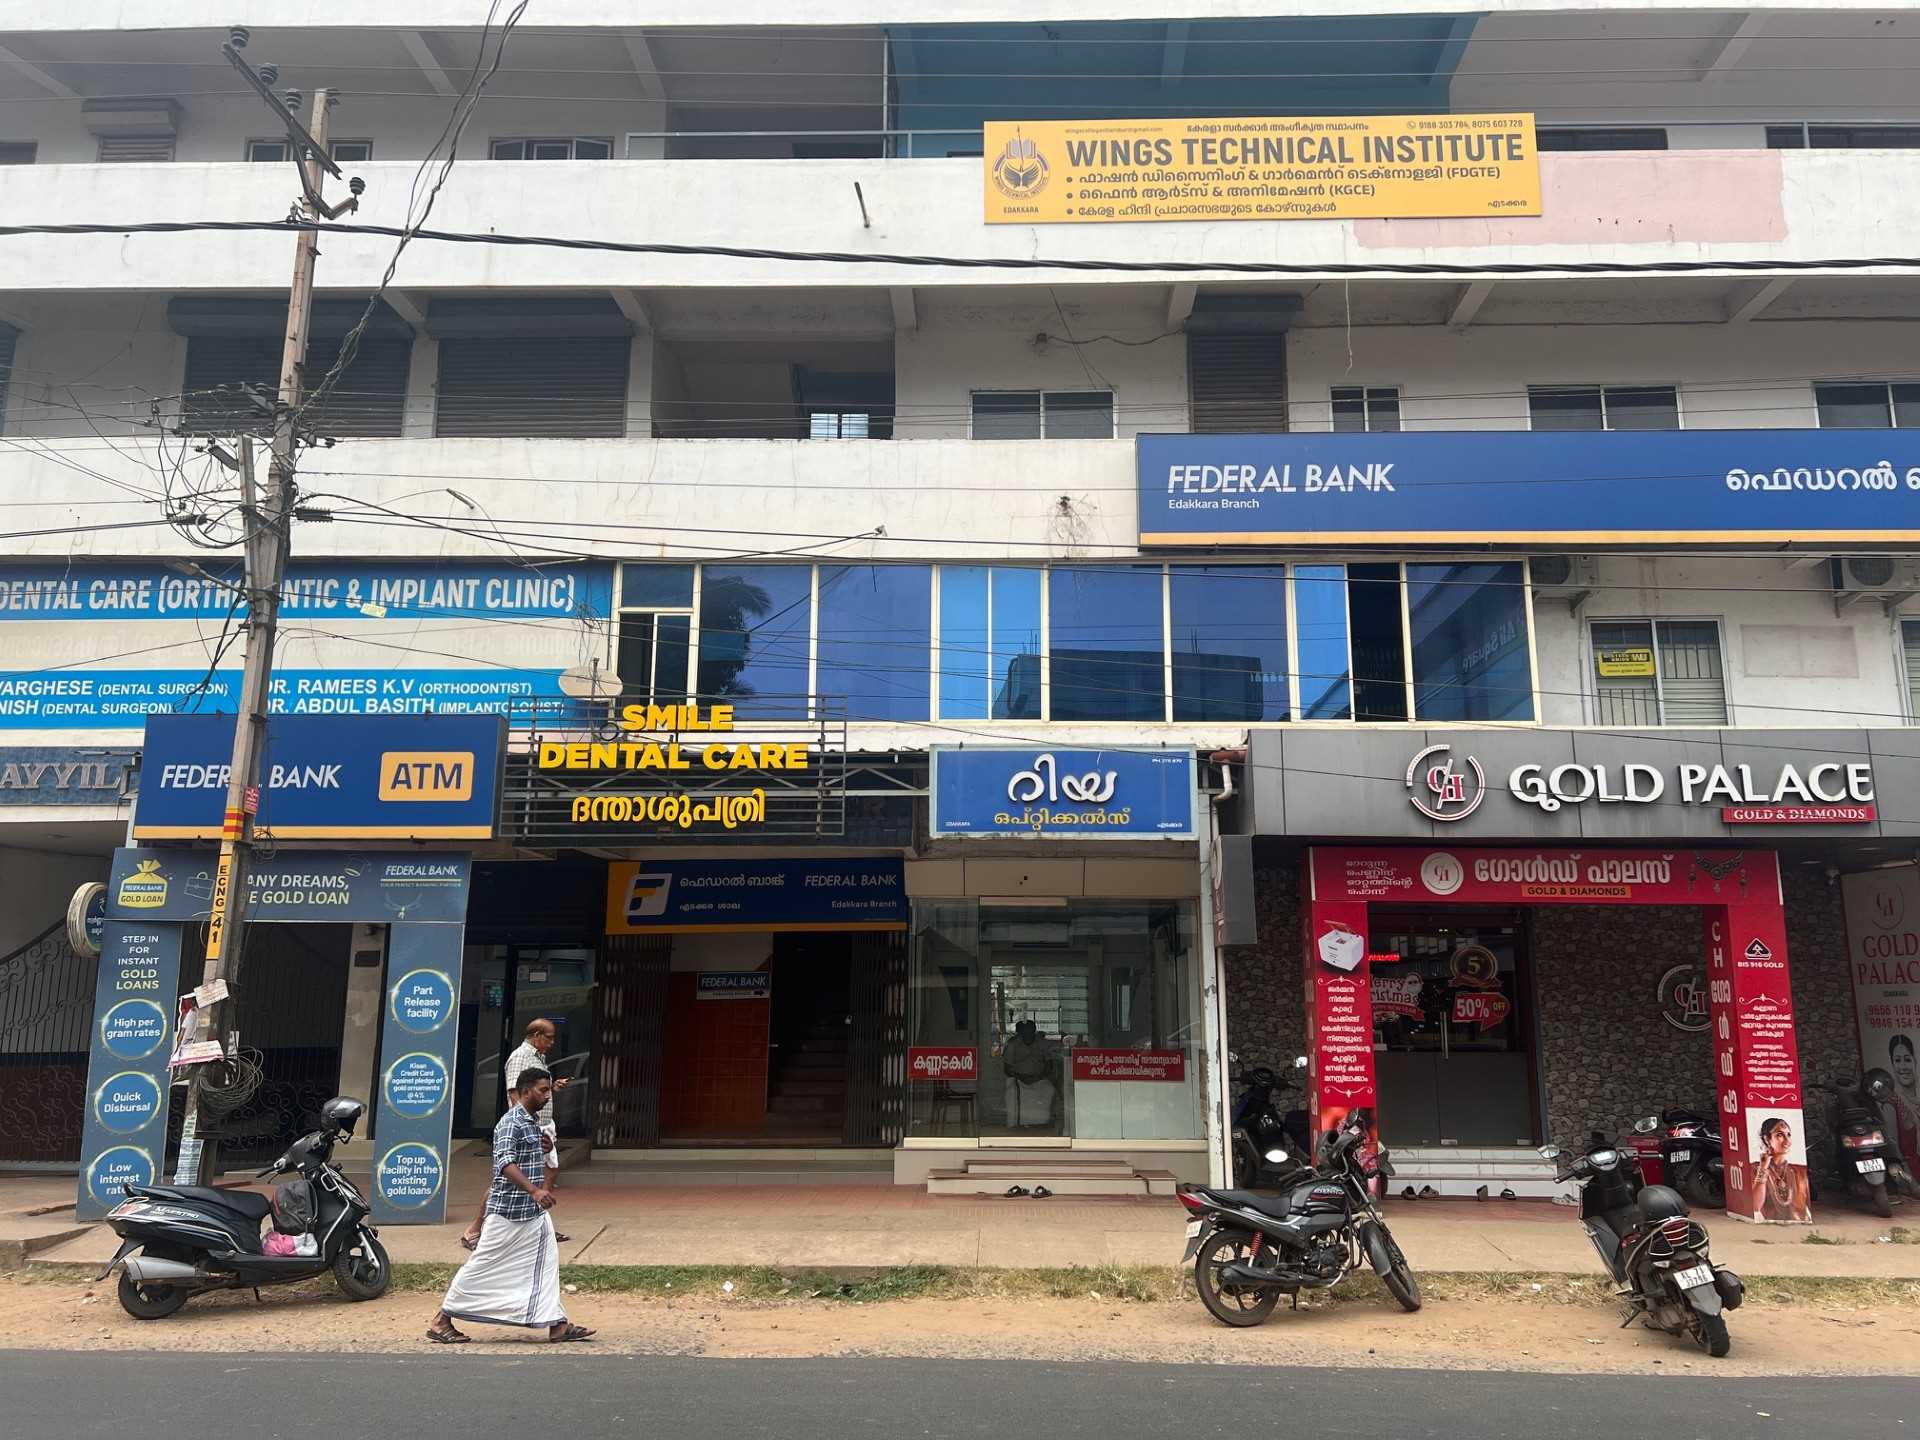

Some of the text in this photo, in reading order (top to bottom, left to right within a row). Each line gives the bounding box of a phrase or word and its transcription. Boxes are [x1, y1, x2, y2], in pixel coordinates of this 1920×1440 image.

[1066, 133, 1525, 167] WINGS TECHNICAL INSTITUTE
[1079, 169, 1139, 183] ഫാഷൻ
[1249, 170, 1259, 181] &
[1447, 166, 1501, 180] (FDGTE)
[1080, 186, 1138, 200] ഫൈൻ
[1213, 186, 1222, 198] &
[1227, 183, 1325, 199] അനിമേഷൻ
[1330, 183, 1376, 198] (KGCE)
[1078, 205, 1115, 217] കേരള
[1168, 463, 1396, 493] FEDERAL BANK
[1726, 460, 1897, 490] ഫെഡറൽ
[1169, 498, 1260, 510] Edakkara Branch
[0, 580, 82, 610] DENTAL
[89, 579, 152, 610] CARE
[345, 578, 362, 608] &
[370, 578, 480, 609] IMPLANT
[486, 575, 575, 613] CLINIC)
[98, 683, 153, 698] (DENTAL
[157, 682, 229, 698] SURGEON)
[298, 679, 377, 695] RAMEES
[383, 679, 414, 695] K.V
[419, 682, 533, 697] (ORTHODONTIST)
[42, 702, 97, 716] (DENTAL
[101, 702, 174, 716] SURGEON)
[267, 698, 290, 713] R.
[294, 698, 359, 714] ABDUL
[368, 698, 435, 714] BASITH
[622, 704, 735, 732] SMILE
[538, 742, 808, 770] DENTAL CARE
[268, 764, 343, 788] BANK
[390, 762, 463, 790] ATM
[1508, 762, 1875, 812] GOLD PALACE
[571, 787, 766, 829] ദന്താശുപത്രി
[1733, 808, 1865, 821] GOLD & DIAMONDS
[385, 865, 459, 876] FEDERAL BANK
[1588, 853, 1674, 884] പാലസ്
[281, 874, 350, 891] DREAMS,
[680, 873, 746, 887] ഫെഡറൽ
[805, 874, 898, 887] FEDERAL BANK
[1527, 886, 1558, 895] GOLD
[1569, 886, 1626, 896] DIAMONDS
[120, 895, 164, 903] GOLD LOAN
[262, 890, 309, 904] GOLD
[309, 890, 350, 905] LOAN
[832, 900, 897, 909] Edakkara Branch
[122, 935, 160, 944] STEP IN
[1863, 933, 1919, 958] GOLD
[129, 946, 151, 954] FOR
[118, 957, 160, 966] INSTANT
[1763, 961, 1785, 969] GOLD
[120, 969, 157, 979] GOLD
[116, 980, 160, 990] LOANS
[413, 986, 433, 996] Part
[404, 997, 441, 1007] Release
[407, 1008, 439, 1020] facility
[1456, 998, 1490, 1019] 50%
[114, 1017, 155, 1029] High per
[106, 1029, 161, 1040] gram rates
[914, 1050, 974, 1077] കണ്ണടകൾ
[112, 1091, 142, 1104] Quick
[103, 1101, 152, 1113] Disbursal
[396, 1154, 426, 1166] Top up
[109, 1163, 132, 1173] Low
[382, 1165, 438, 1176] facility in the
[99, 1173, 141, 1184] interest
[391, 1176, 427, 1187] existing
[386, 1186, 432, 1198] gold loans
